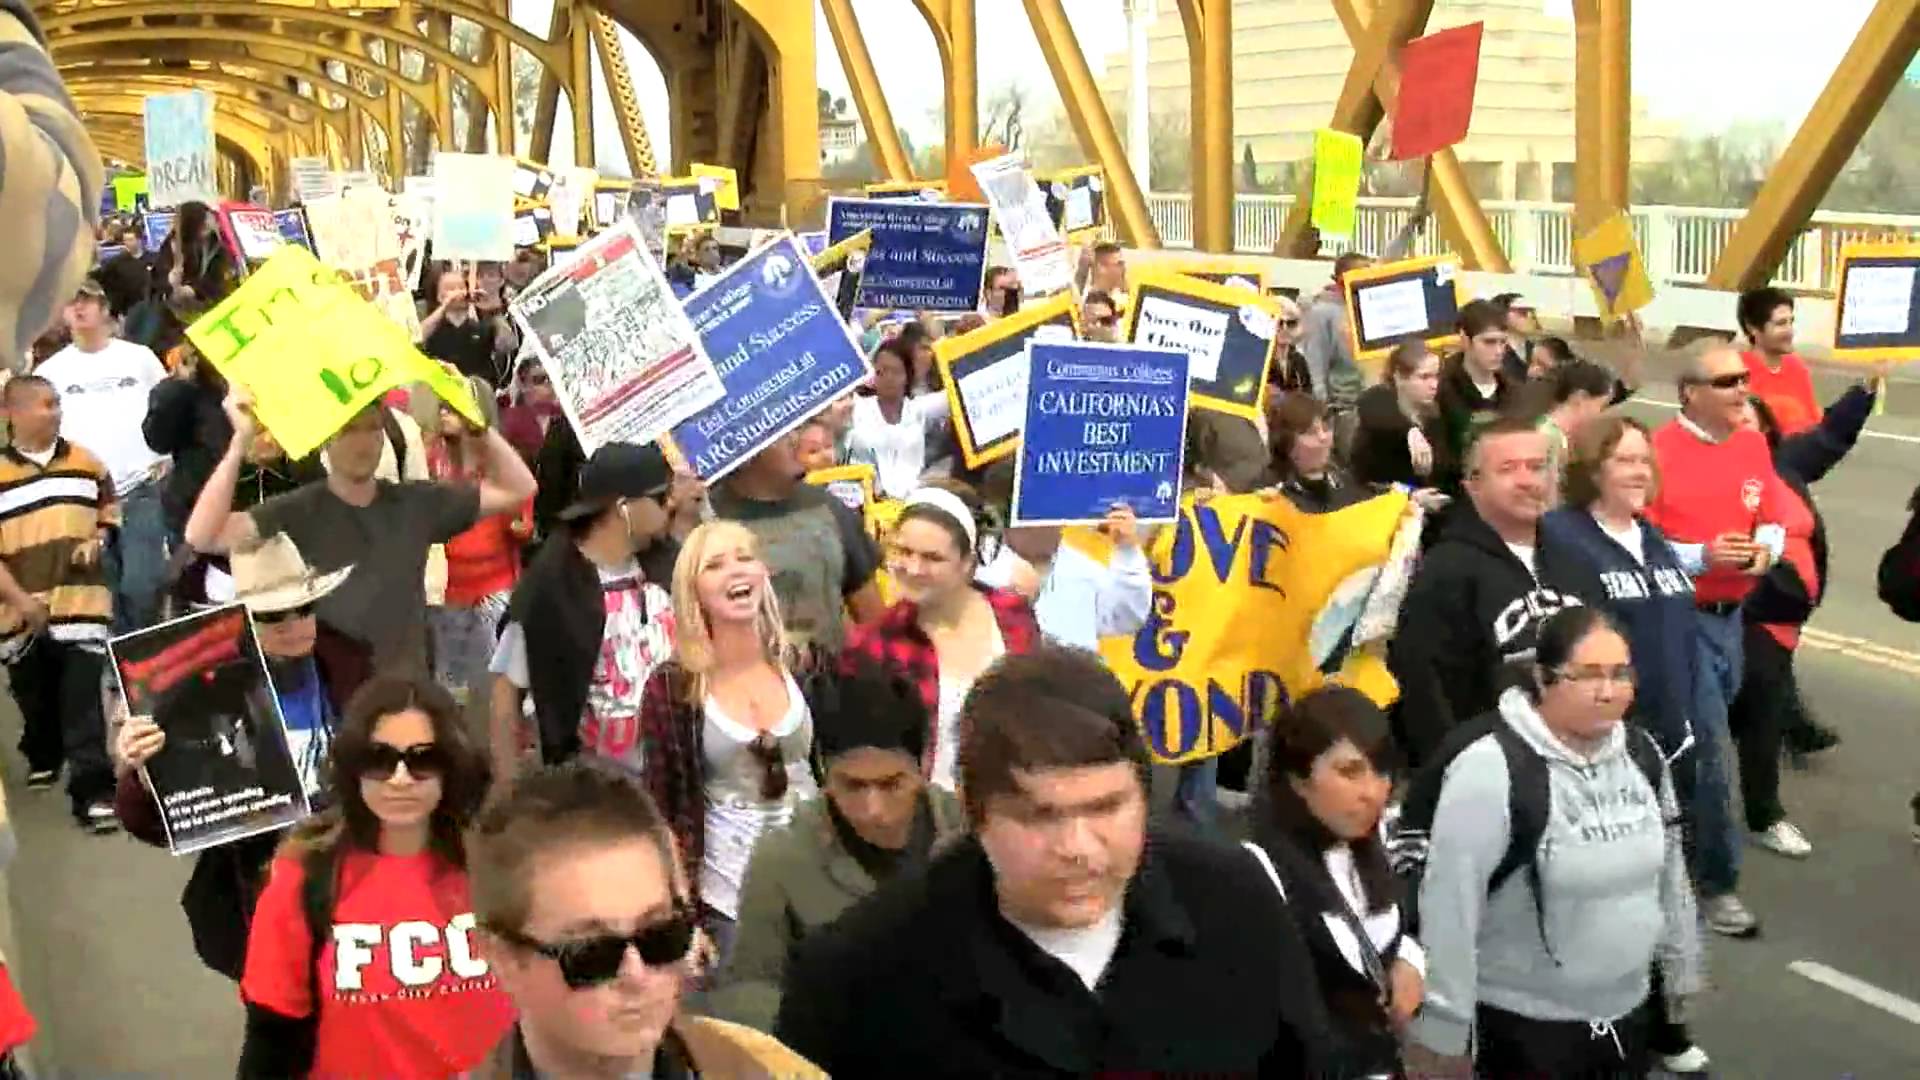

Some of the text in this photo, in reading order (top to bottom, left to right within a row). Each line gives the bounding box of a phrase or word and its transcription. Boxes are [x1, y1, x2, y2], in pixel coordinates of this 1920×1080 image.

[749, 302, 823, 351] Success
[1038, 389, 1176, 418] CALIFORNIA'S
[1082, 420, 1133, 446] BEST
[1036, 450, 1173, 475] INVESTMENT
[1133, 590, 1191, 672] &
[332, 911, 490, 991] FCC
